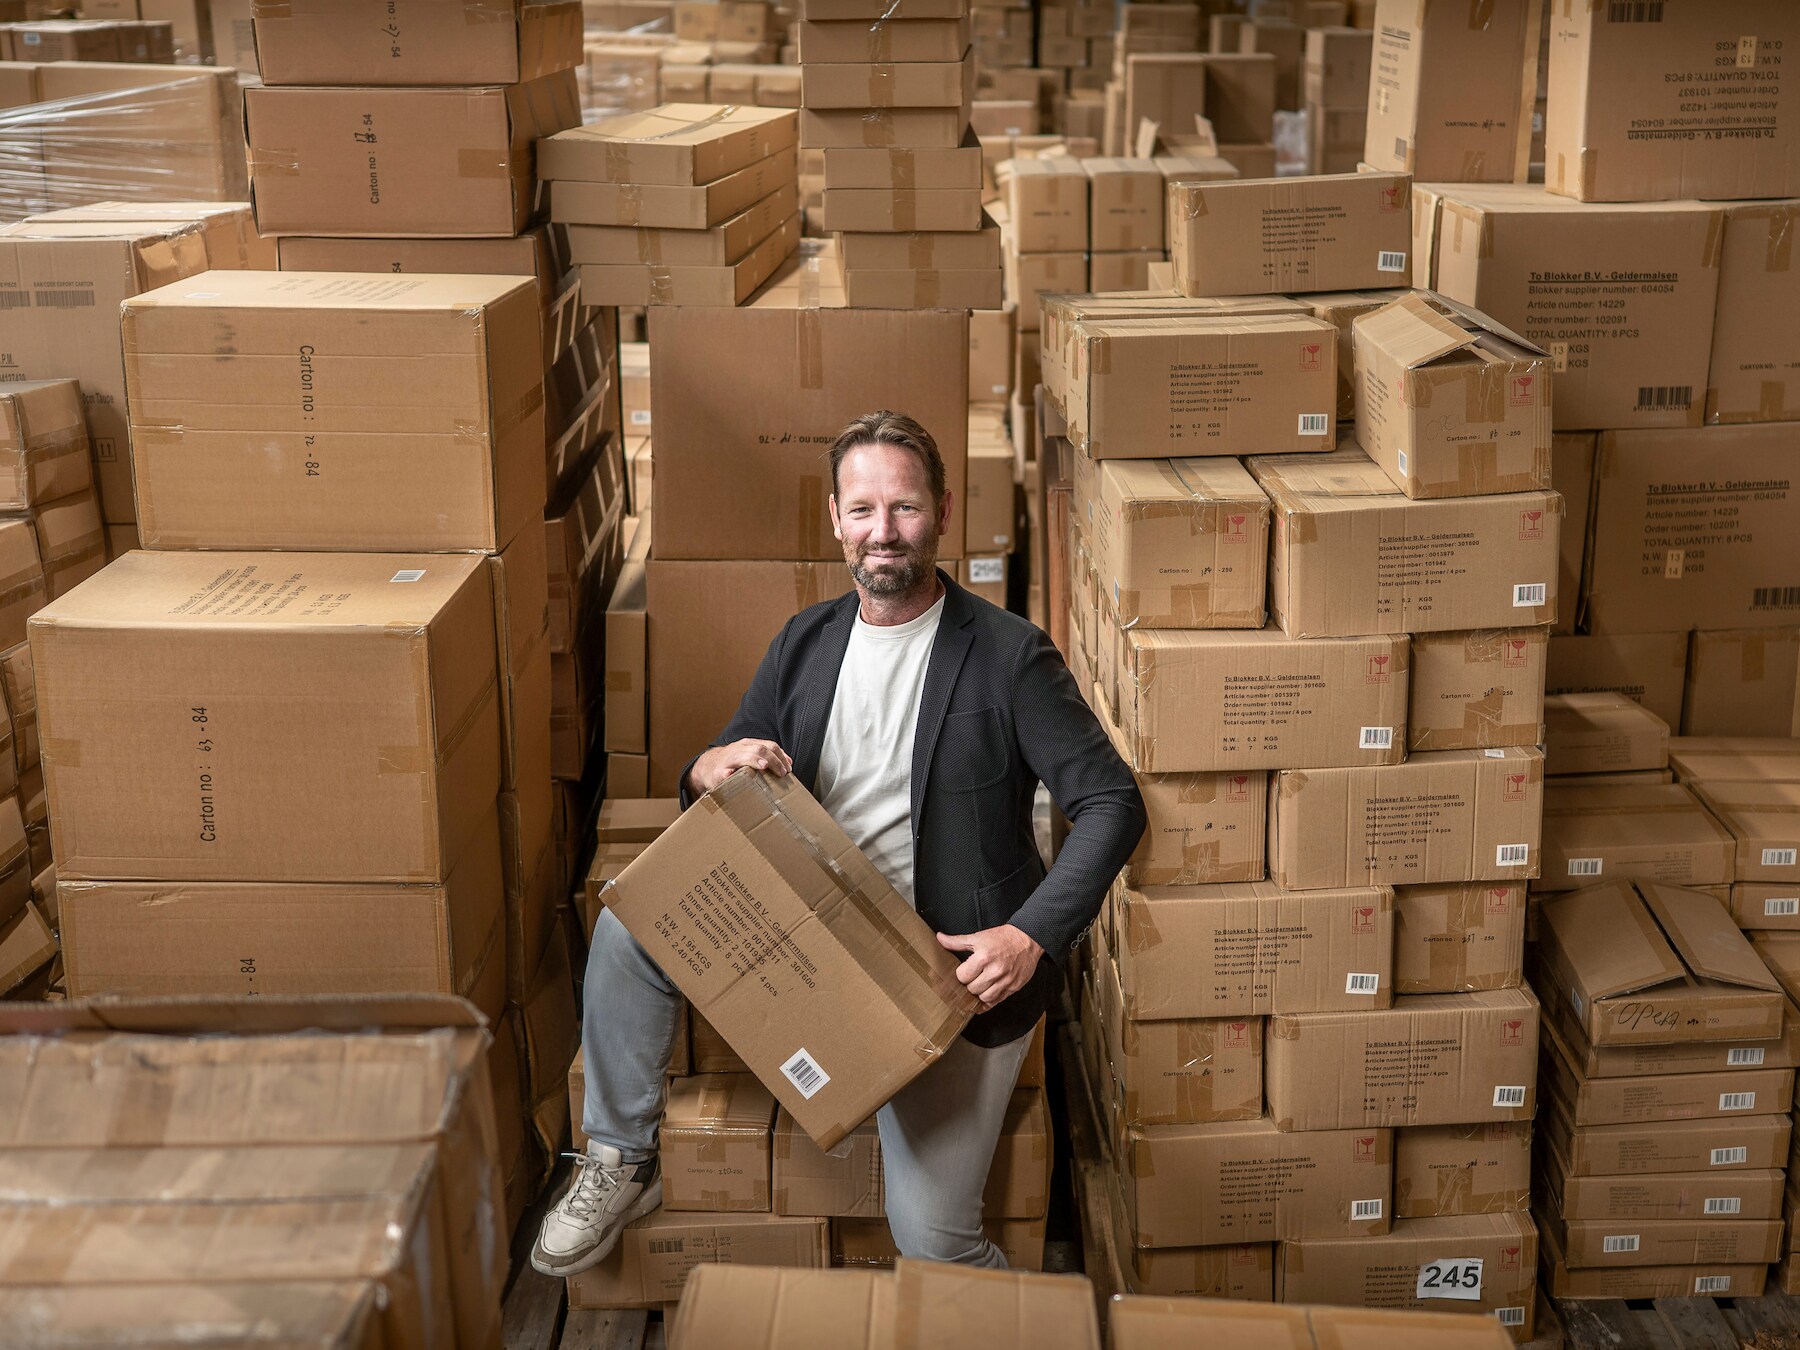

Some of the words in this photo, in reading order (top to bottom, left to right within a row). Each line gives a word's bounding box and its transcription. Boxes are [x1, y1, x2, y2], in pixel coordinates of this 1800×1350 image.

[1716, 42, 1736, 50] KGS
[1743, 40, 1753, 48] 14
[391, 46, 401, 58] 54
[1715, 57, 1736, 65] KGS
[1741, 55, 1751, 63] 13
[1665, 73, 1685, 82] PCS
[1678, 88, 1711, 96] 101937
[1752, 86, 1779, 94] Order
[1680, 103, 1707, 111] 14229
[362, 113, 372, 125] 54
[1632, 119, 1664, 127] 604054
[1705, 116, 1740, 125] supplier
[1743, 116, 1777, 124] Blokker
[1628, 131, 1695, 140] Geldermalsen
[1726, 131, 1761, 139] Blokker
[370, 171, 380, 204] Carton
[1530, 272, 1542, 281] To
[1544, 272, 1581, 280] Blokker
[1584, 272, 1602, 280] B.V.
[1611, 272, 1678, 280] Geldermalsen
[1529, 286, 1563, 294] Blokker
[1565, 286, 1601, 295] supplier
[1603, 286, 1639, 294] number:
[1641, 285, 1674, 293] 604054
[1527, 301, 1557, 309] Article
[1598, 300, 1625, 308] 14229
[1526, 316, 1553, 324] Order
[1595, 315, 1627, 324] 102091
[1525, 330, 1556, 338] TOTAL
[1558, 330, 1609, 338] QUANTITY:
[1619, 329, 1640, 337] PCS
[1553, 346, 1564, 354] 13
[1569, 345, 1589, 353] KGS
[300, 345, 315, 390] Carton
[1552, 361, 1562, 369] 14
[1568, 359, 1589, 368] KGS
[302, 395, 314, 412] no
[758, 435, 770, 444] 76
[813, 435, 837, 445] arton
[305, 461, 320, 477] 84
[1648, 485, 1658, 493] To
[1661, 484, 1696, 492] Blokker
[1699, 482, 1717, 490] B.V.
[1725, 480, 1790, 489] Geldermalsen
[1647, 497, 1679, 505] Blokker
[1681, 495, 1715, 504] supplier
[1754, 492, 1786, 500] 604054
[1645, 511, 1673, 519] Article
[1713, 508, 1739, 516] 14229
[1644, 525, 1669, 533] Order
[1709, 521, 1740, 530] 102091
[192, 707, 208, 722] 84
[200, 774, 213, 791] no
[200, 796, 216, 842] Carton
[701, 877, 724, 903] Article
[723, 902, 751, 935] number:
[751, 934, 781, 965] 0013811
[718, 861, 729, 873] To
[728, 871, 755, 902] Blokker
[754, 901, 769, 917] B.V.
[772, 922, 818, 974] Geldermalsen
[694, 884, 714, 908] Order
[713, 907, 742, 940] number:
[741, 938, 767, 966] 101935
[709, 869, 736, 900] Blokker
[735, 900, 764, 931] supplier
[762, 930, 791, 962] number:
[790, 962, 816, 989] 301600
[678, 899, 695, 920] Total
[694, 919, 722, 952] quantity:
[731, 962, 746, 977] pcs
[685, 891, 704, 913] Inner
[703, 913, 734, 947] quantity:
[737, 951, 757, 972] inner
[763, 981, 779, 997] pcs
[680, 934, 696, 952] 1.95
[695, 950, 712, 969] KGS
[240, 957, 256, 973] 84
[671, 942, 687, 959] 2.40
[686, 958, 704, 977] KGS
[1422, 1265, 1479, 1289] 245
